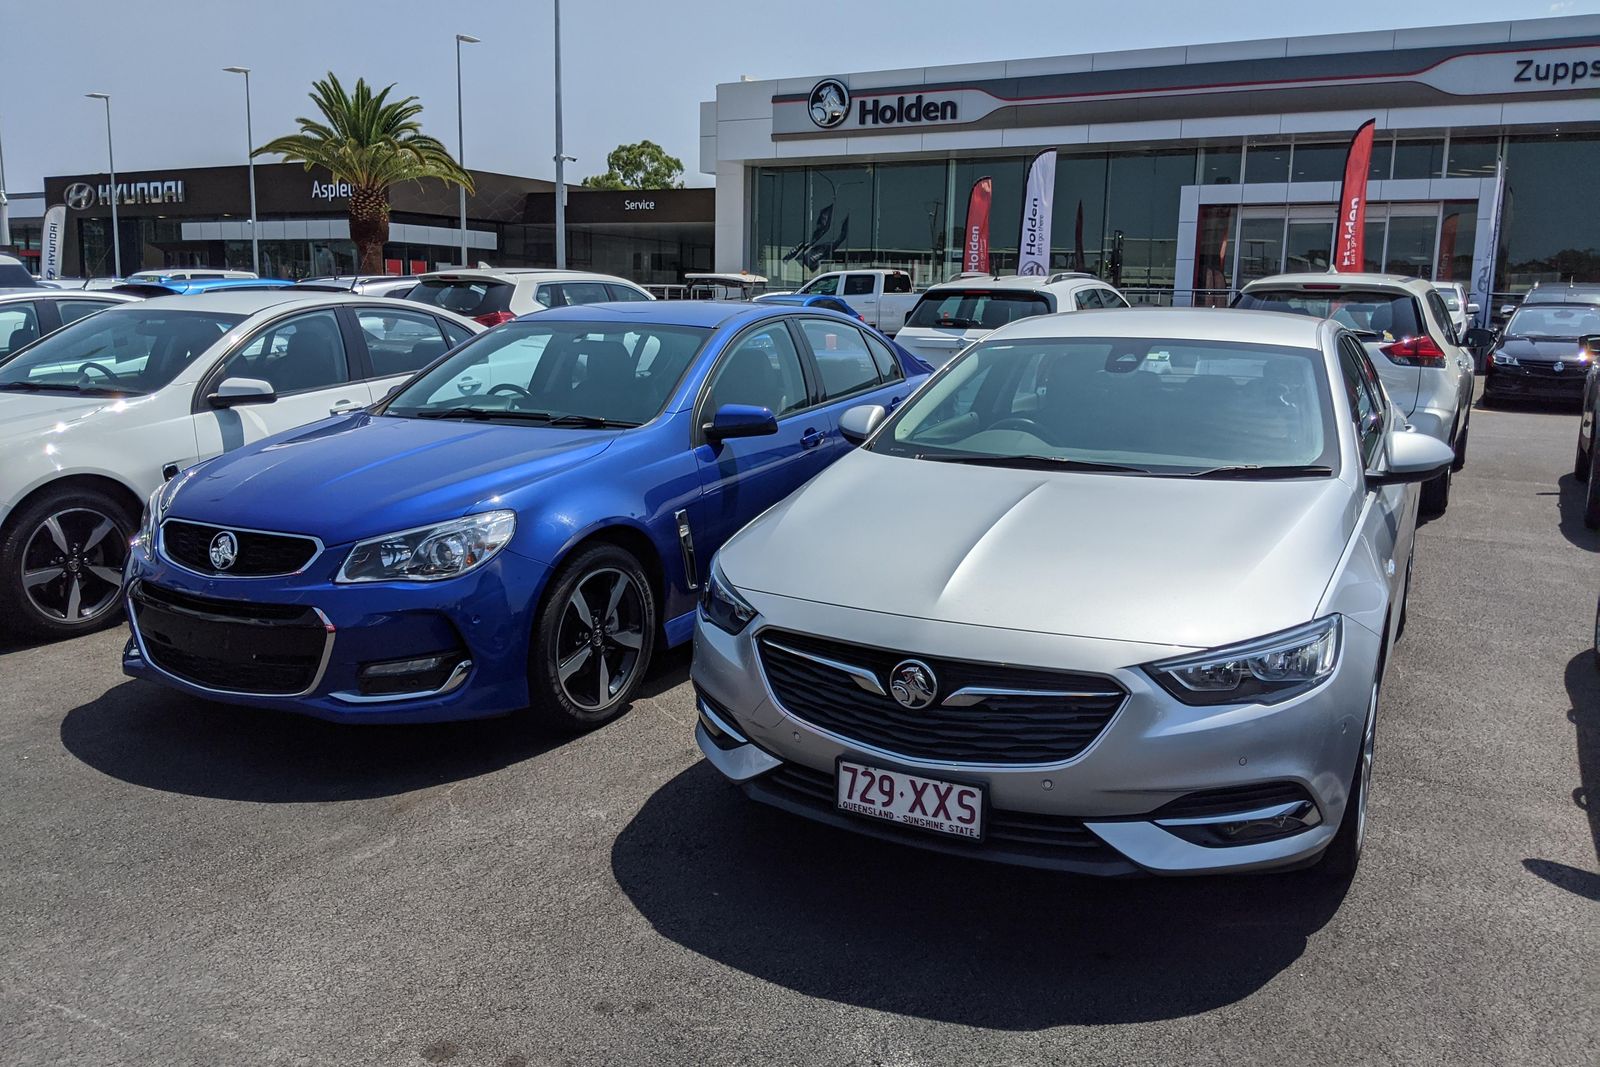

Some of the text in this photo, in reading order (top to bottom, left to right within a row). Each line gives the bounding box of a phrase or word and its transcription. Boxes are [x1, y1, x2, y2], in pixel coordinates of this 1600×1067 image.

[1514, 59, 1600, 85] Zupps
[859, 95, 958, 125] Holden
[98, 181, 183, 206] HYUNDAI
[624, 199, 655, 210] Service
[1026, 197, 1038, 256] Holden
[48, 222, 58, 266] HYUNDAI
[968, 225, 979, 272] Holden
[843, 801, 894, 819] QUEENSLAND
[902, 815, 945, 831] SUNSHINE
[948, 824, 975, 837] STATE
